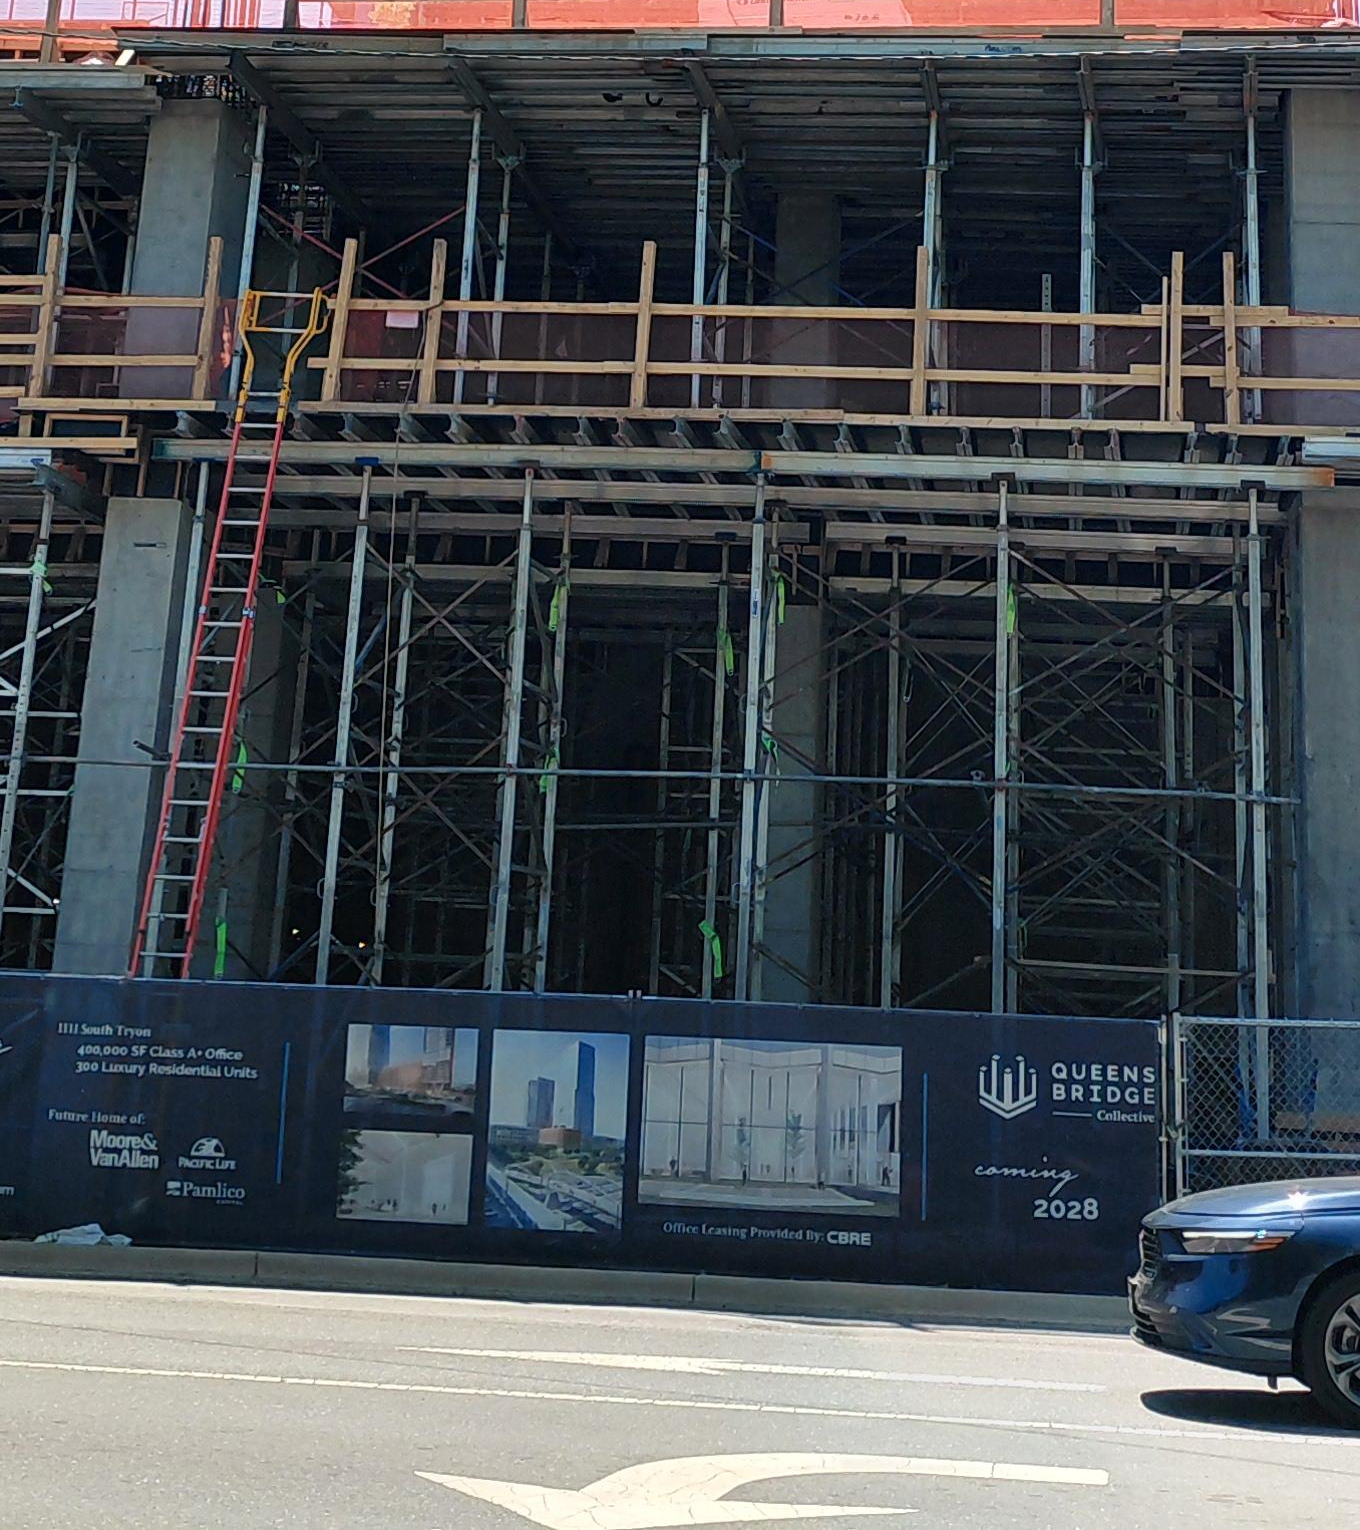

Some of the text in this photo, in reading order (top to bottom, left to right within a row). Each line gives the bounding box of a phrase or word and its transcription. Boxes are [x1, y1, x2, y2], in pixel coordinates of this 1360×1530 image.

[58, 1022, 151, 1039] 1111 South Tryon
[77, 1045, 128, 1057] 400,000
[131, 1045, 147, 1057] SF
[149, 1046, 184, 1058] Class
[204, 1048, 243, 1060] Office
[75, 1061, 258, 1079] 300 Luxury Residential Units
[1051, 1062, 1155, 1083] QUEENS
[1052, 1083, 1155, 1104] BRIDGE
[48, 1109, 89, 1122] Future
[91, 1111, 127, 1124] Home
[1096, 1109, 1155, 1123] Collective
[974, 1156, 1079, 1197] coming
[183, 1182, 246, 1199] Pamlico
[1033, 1198, 1099, 1220] 2028
[663, 1221, 699, 1234] Office
[701, 1224, 747, 1240] Leasing
[750, 1227, 803, 1241] Provided
[827, 1230, 871, 1246] CBRE
